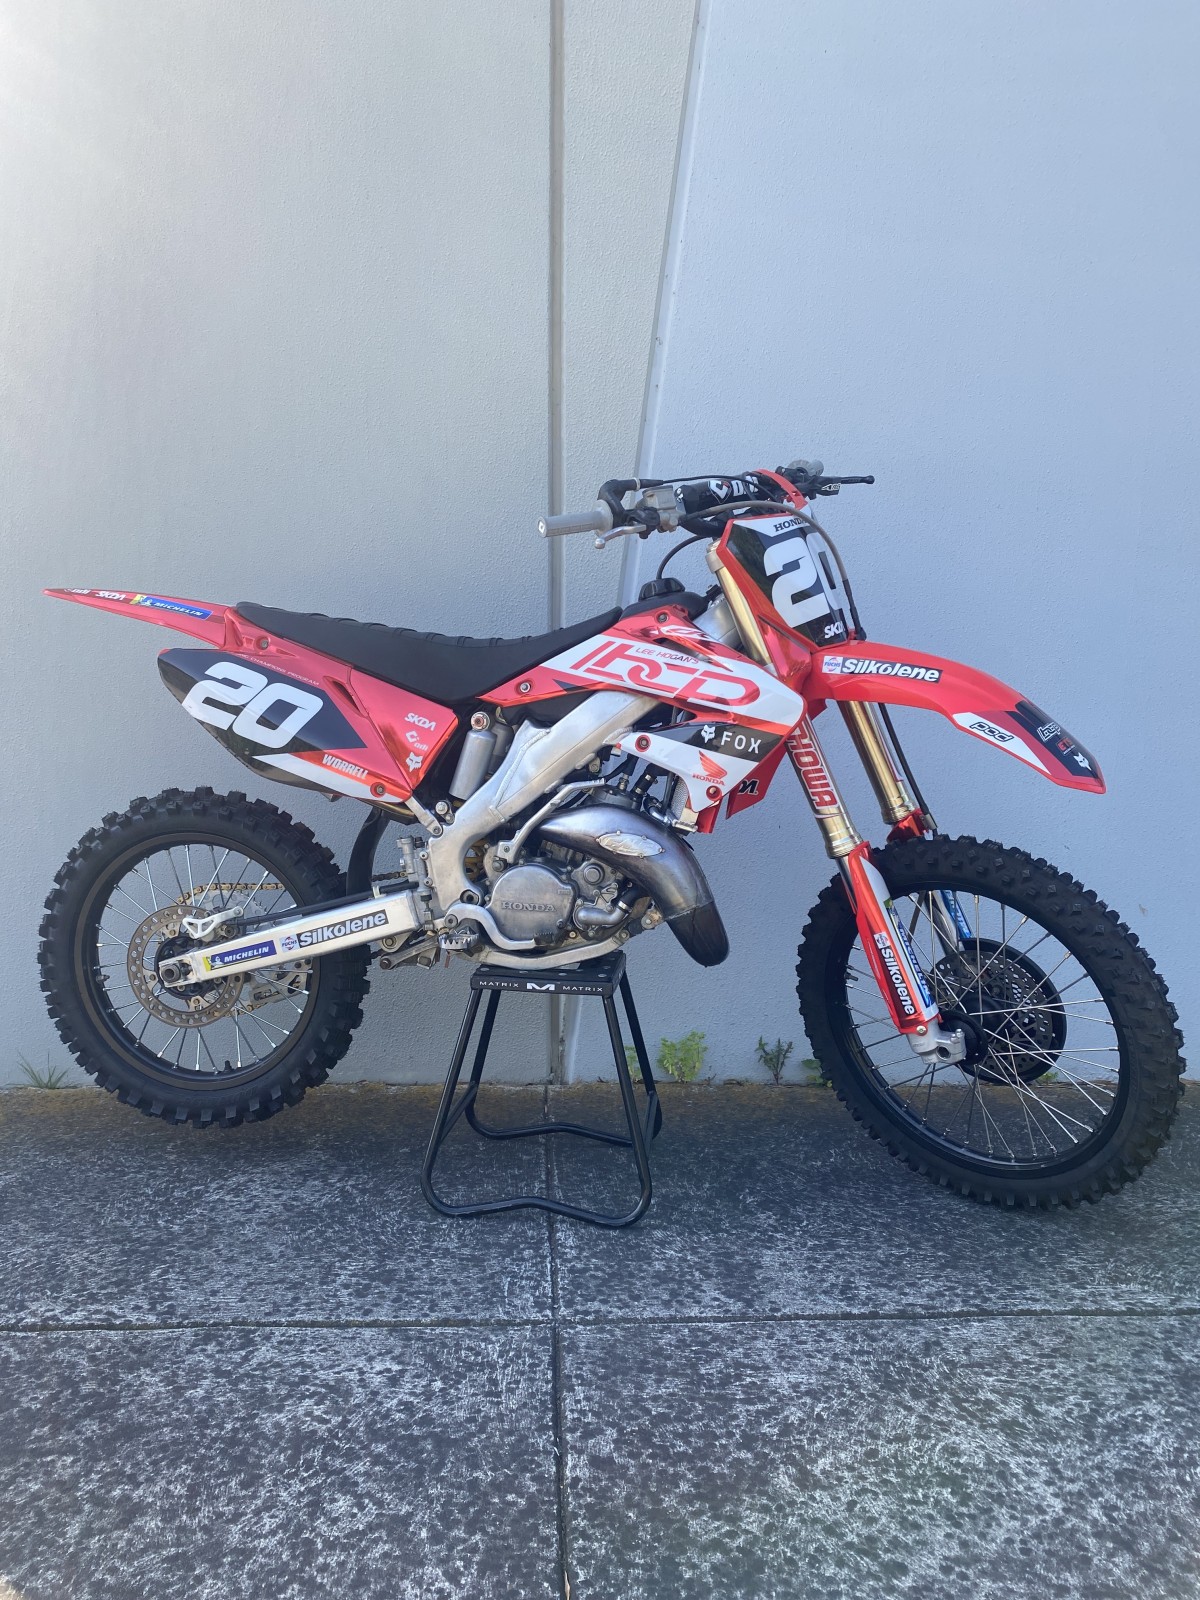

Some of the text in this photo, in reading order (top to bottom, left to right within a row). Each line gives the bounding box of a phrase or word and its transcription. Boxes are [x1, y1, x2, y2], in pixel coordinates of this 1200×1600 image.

[153, 602, 203, 616] MICHELIN
[636, 647, 699, 665] LEE HOGAN'S
[250, 656, 286, 673] CHAMPIONS
[287, 671, 320, 686] PROGRAM
[842, 659, 940, 682] Silkolene
[181, 661, 323, 749] 20
[404, 712, 437, 732] SKDA
[969, 721, 1015, 743] pod
[720, 731, 761, 754] FOX
[786, 721, 839, 809] HOWA
[691, 773, 725, 786] HONDA
[501, 901, 556, 912] HONDA
[281, 912, 386, 948] FUCHS Silkolene
[224, 946, 270, 963] MICHELIN
[899, 928, 931, 995] MICHELIN
[881, 947, 915, 1015] Silkolene
